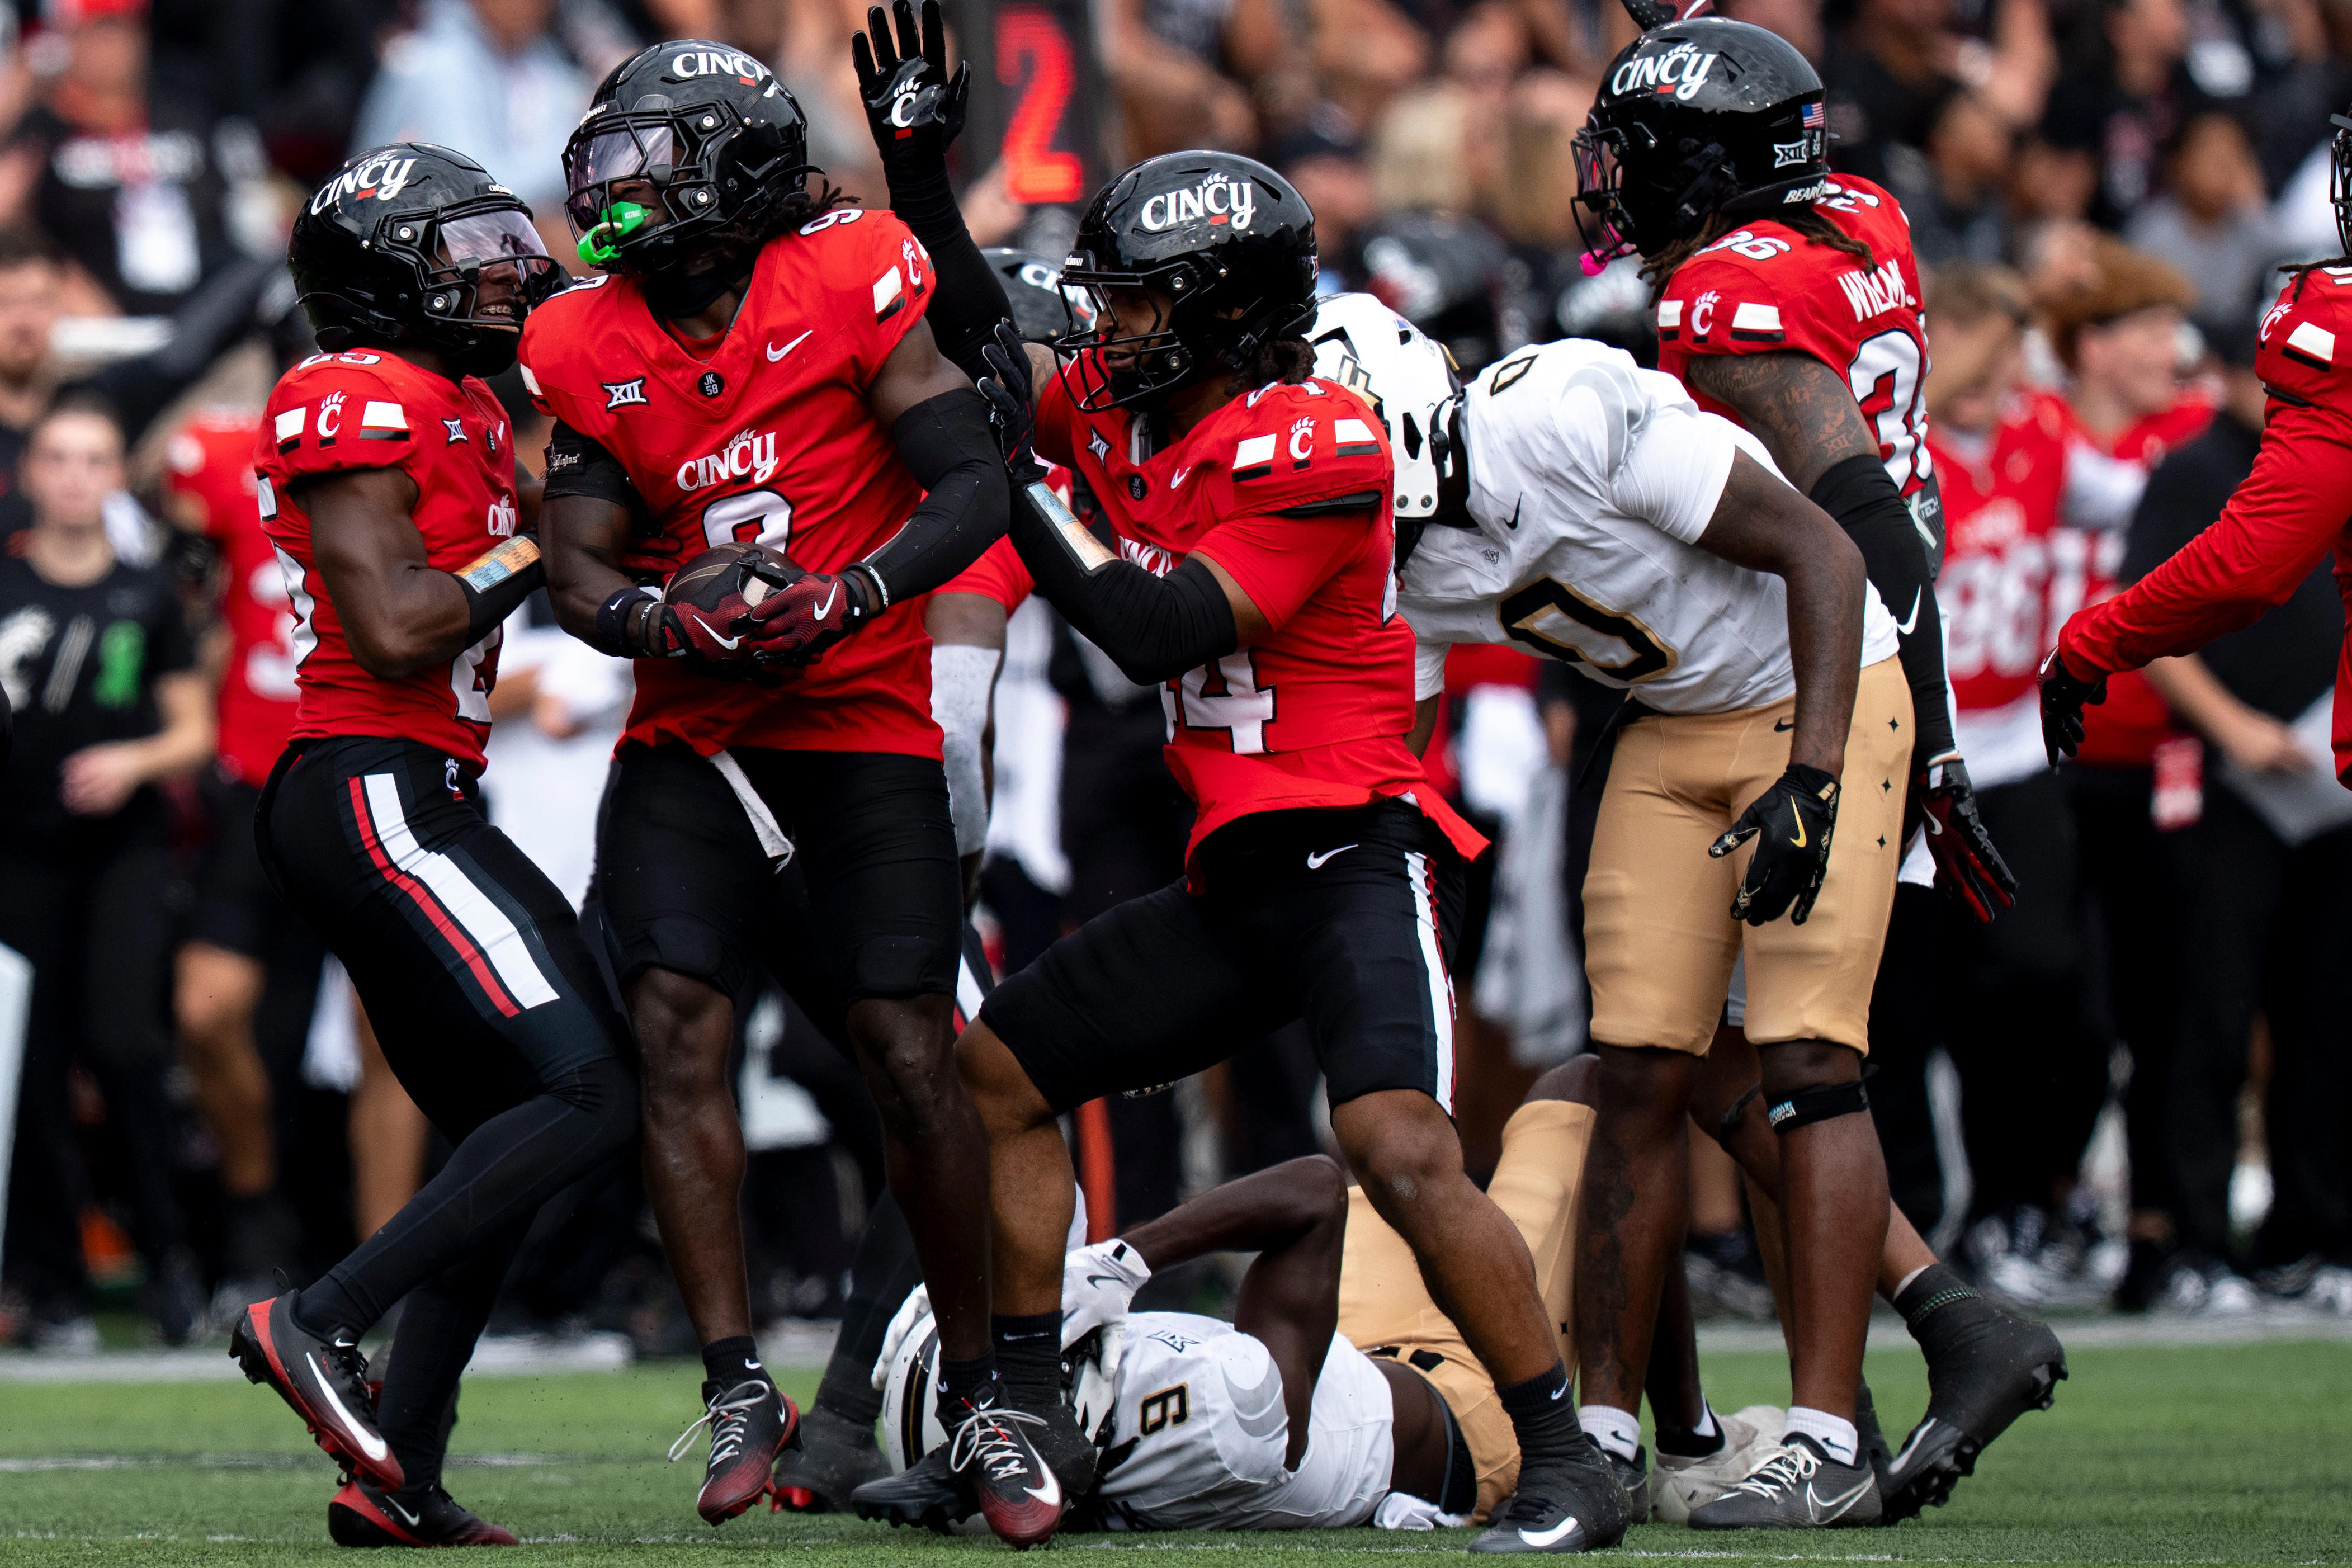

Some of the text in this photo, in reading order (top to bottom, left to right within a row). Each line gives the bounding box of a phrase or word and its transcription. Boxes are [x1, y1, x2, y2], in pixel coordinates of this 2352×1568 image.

[1612, 48, 1716, 101] CINCY
[310, 154, 418, 216] CINCY
[1141, 178, 1256, 230] CINCY
[704, 374, 715, 386] JK
[706, 384, 719, 396] 58
[677, 429, 780, 491] CINCY
[1132, 488, 1141, 498] 58
[1498, 575, 1679, 683] 0
